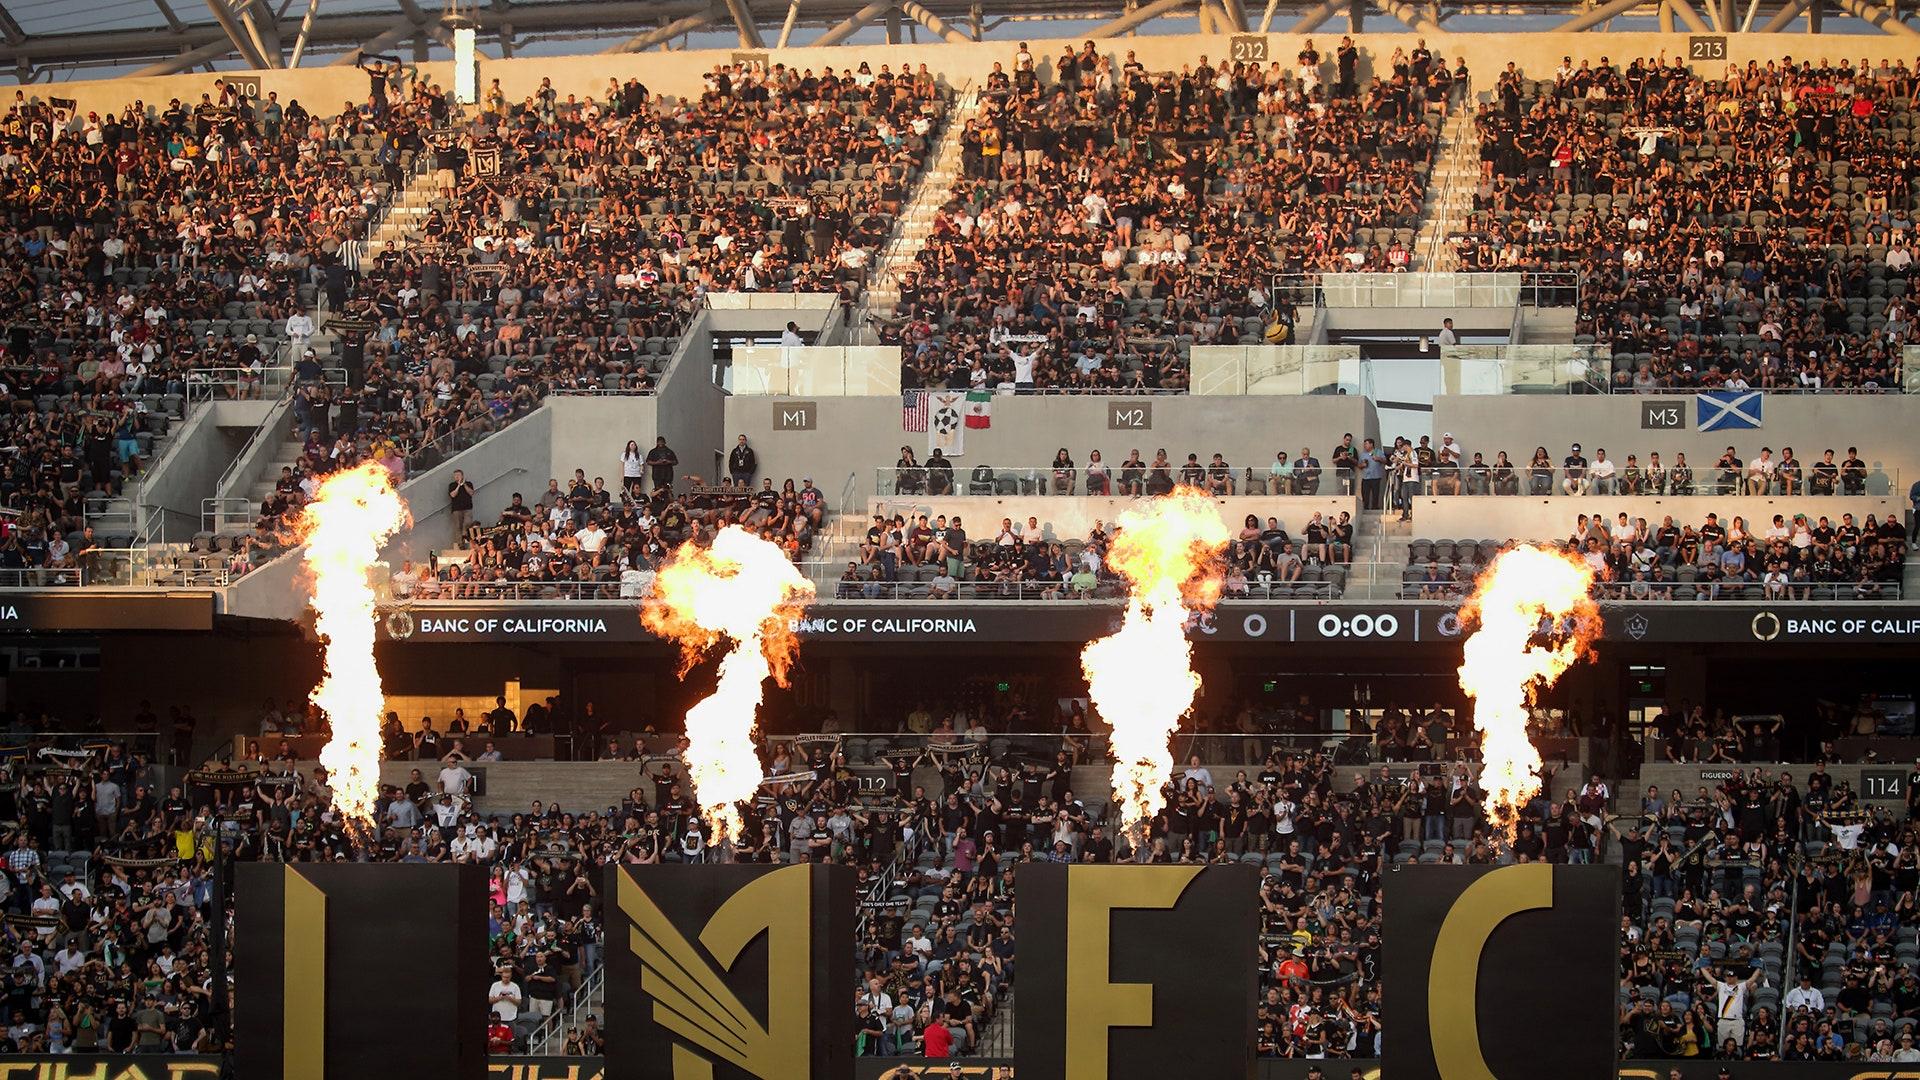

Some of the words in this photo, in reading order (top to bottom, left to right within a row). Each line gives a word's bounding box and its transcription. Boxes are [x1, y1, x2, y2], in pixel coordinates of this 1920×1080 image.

[1235, 42, 1264, 60] 212
[1693, 42, 1723, 57] 213
[783, 410, 806, 426] M1
[1116, 410, 1144, 426] M2
[1649, 408, 1678, 425] M3
[421, 619, 469, 633] BANC
[474, 619, 498, 633] OF
[502, 619, 607, 633] CALIFORNIA
[842, 619, 867, 633] OF
[871, 619, 977, 633] CALIFORNIA
[1243, 614, 1267, 637] 0
[1317, 614, 1399, 637] 0:00
[1787, 619, 1837, 633] BANC
[1842, 619, 1866, 633] OF
[1871, 619, 1920, 633] CALIF
[856, 777, 886, 790] 112
[1867, 777, 1900, 795] 114
